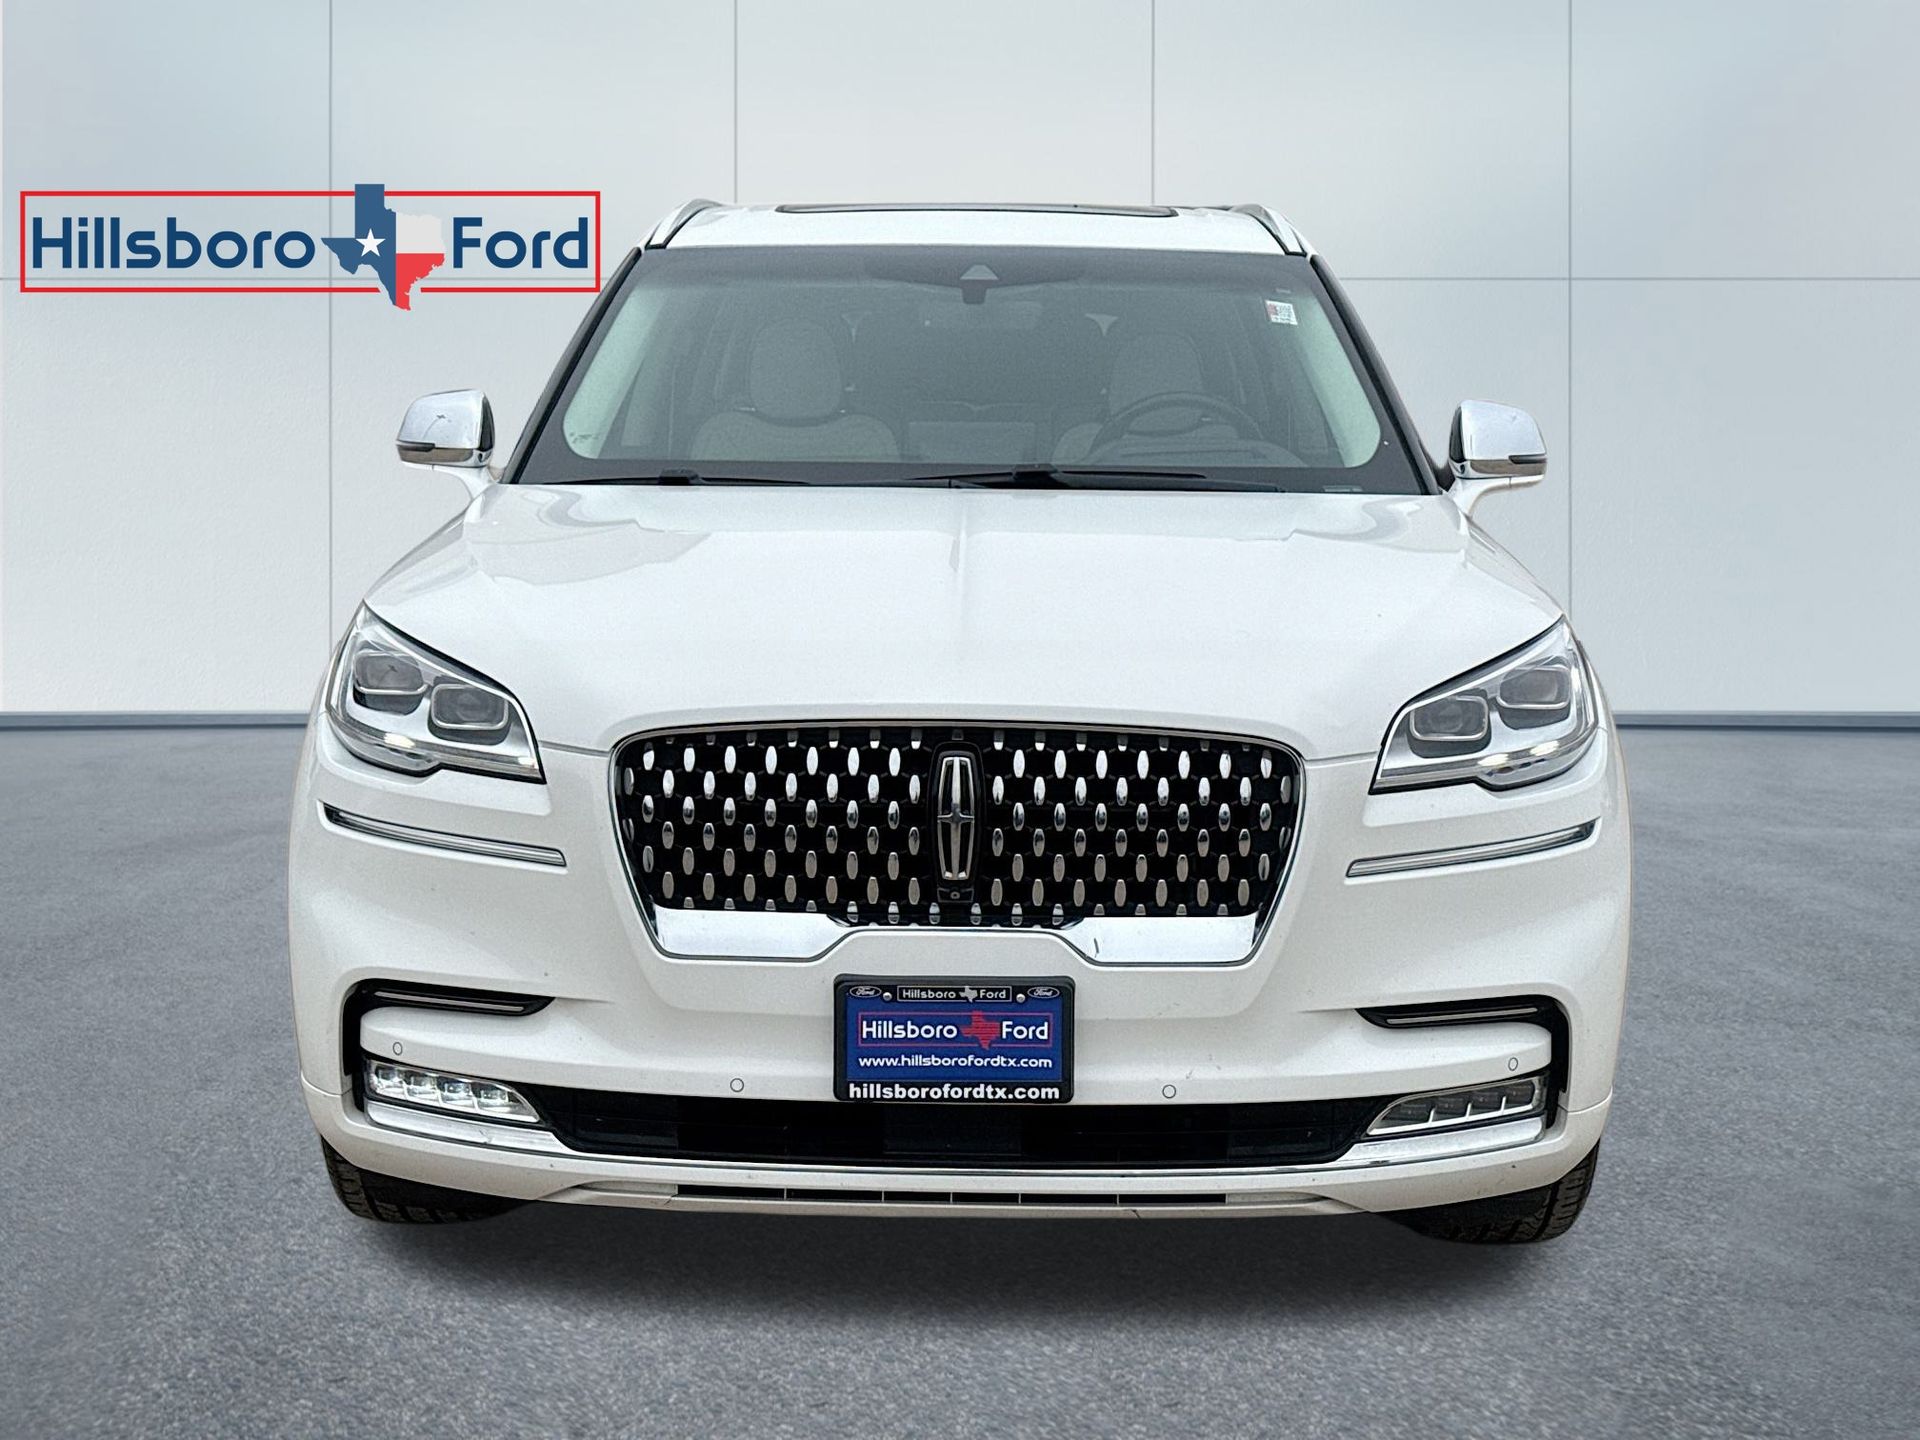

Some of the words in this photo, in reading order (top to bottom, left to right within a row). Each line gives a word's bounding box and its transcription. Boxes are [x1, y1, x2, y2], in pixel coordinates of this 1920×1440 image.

[856, 986, 876, 996] Ford
[902, 989, 956, 999] Hillsboro
[979, 989, 1006, 999] Ford
[1034, 987, 1054, 998] Ford
[862, 1020, 958, 1039] Hillsboro
[1002, 1021, 1049, 1040] Ford
[858, 1055, 1053, 1068] www.hillsborofordtx.com
[850, 1083, 1060, 1100] hillsborofordtx.com
